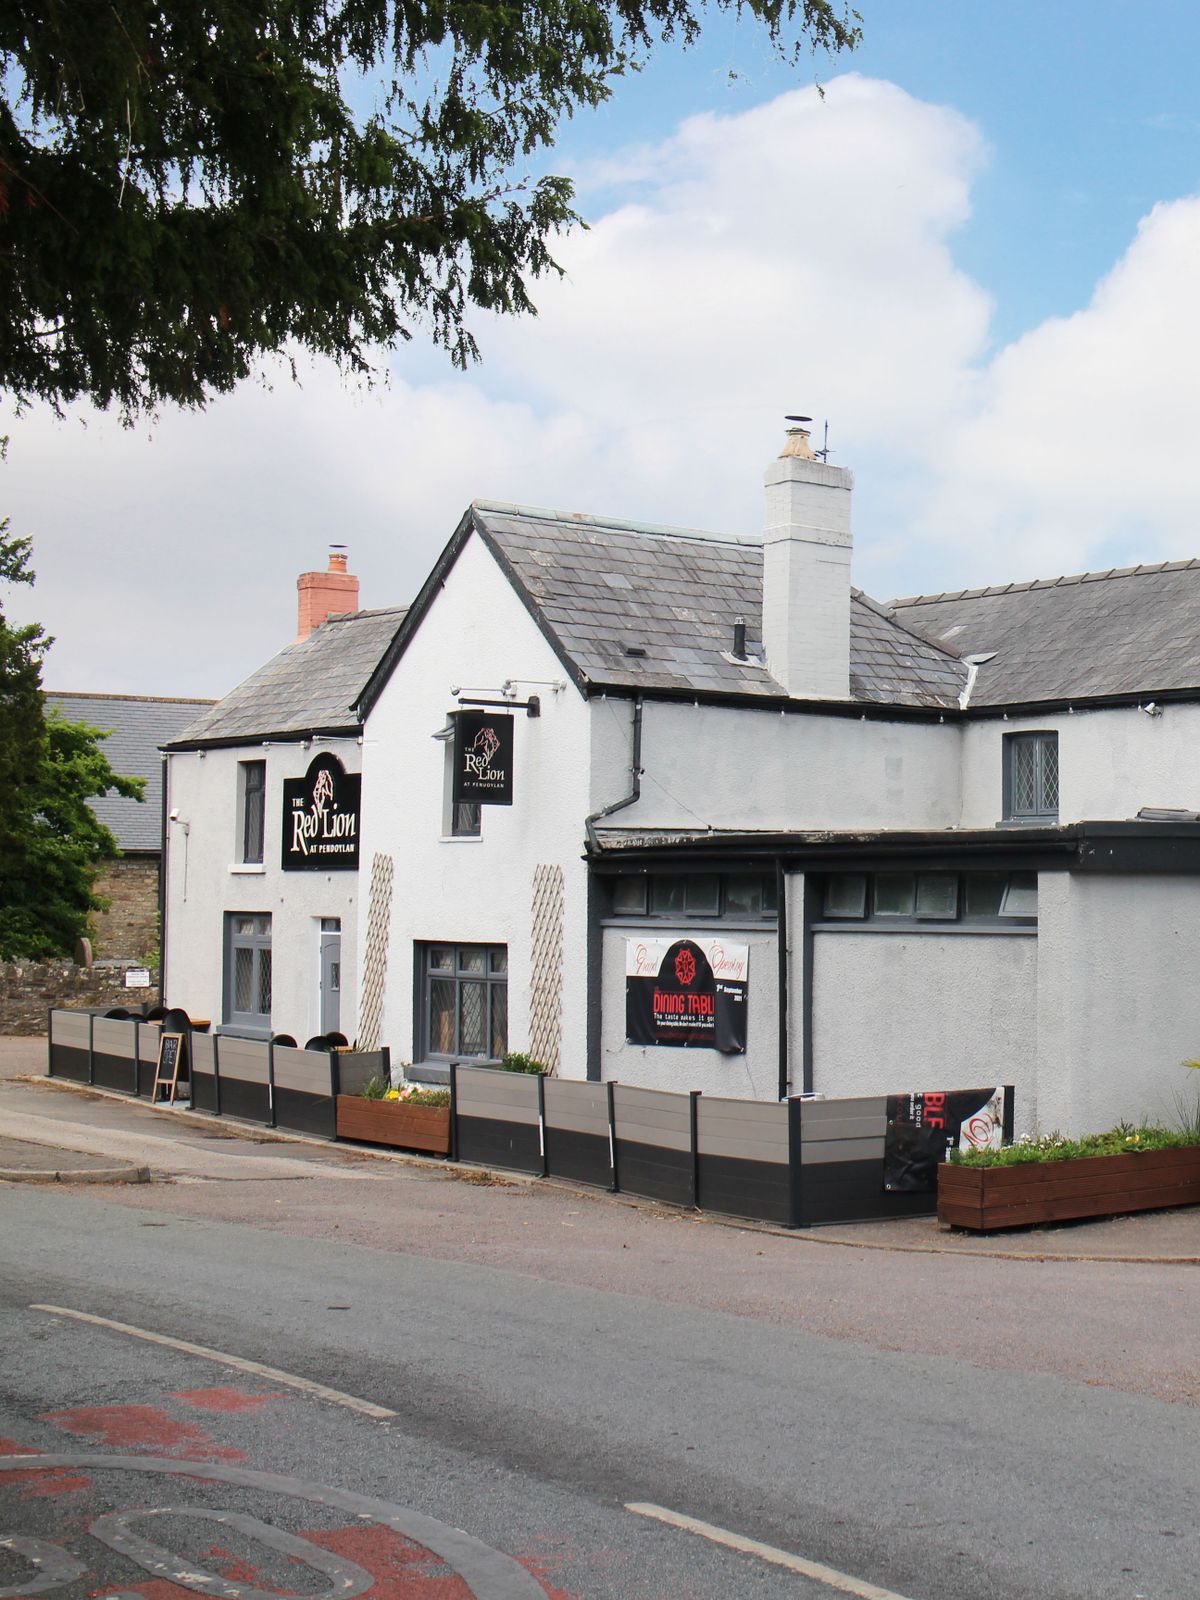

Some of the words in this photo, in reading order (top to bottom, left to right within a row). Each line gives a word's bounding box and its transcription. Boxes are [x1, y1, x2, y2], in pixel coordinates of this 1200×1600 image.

[464, 753, 488, 774] Red
[478, 765, 505, 780] Lion
[292, 798, 304, 807] THE
[290, 804, 319, 855] Red
[322, 803, 356, 838] Lion
[309, 845, 317, 853] AT
[319, 844, 355, 853] PENDOYLAN
[709, 944, 745, 979] Opening
[653, 992, 685, 1014] DINING
